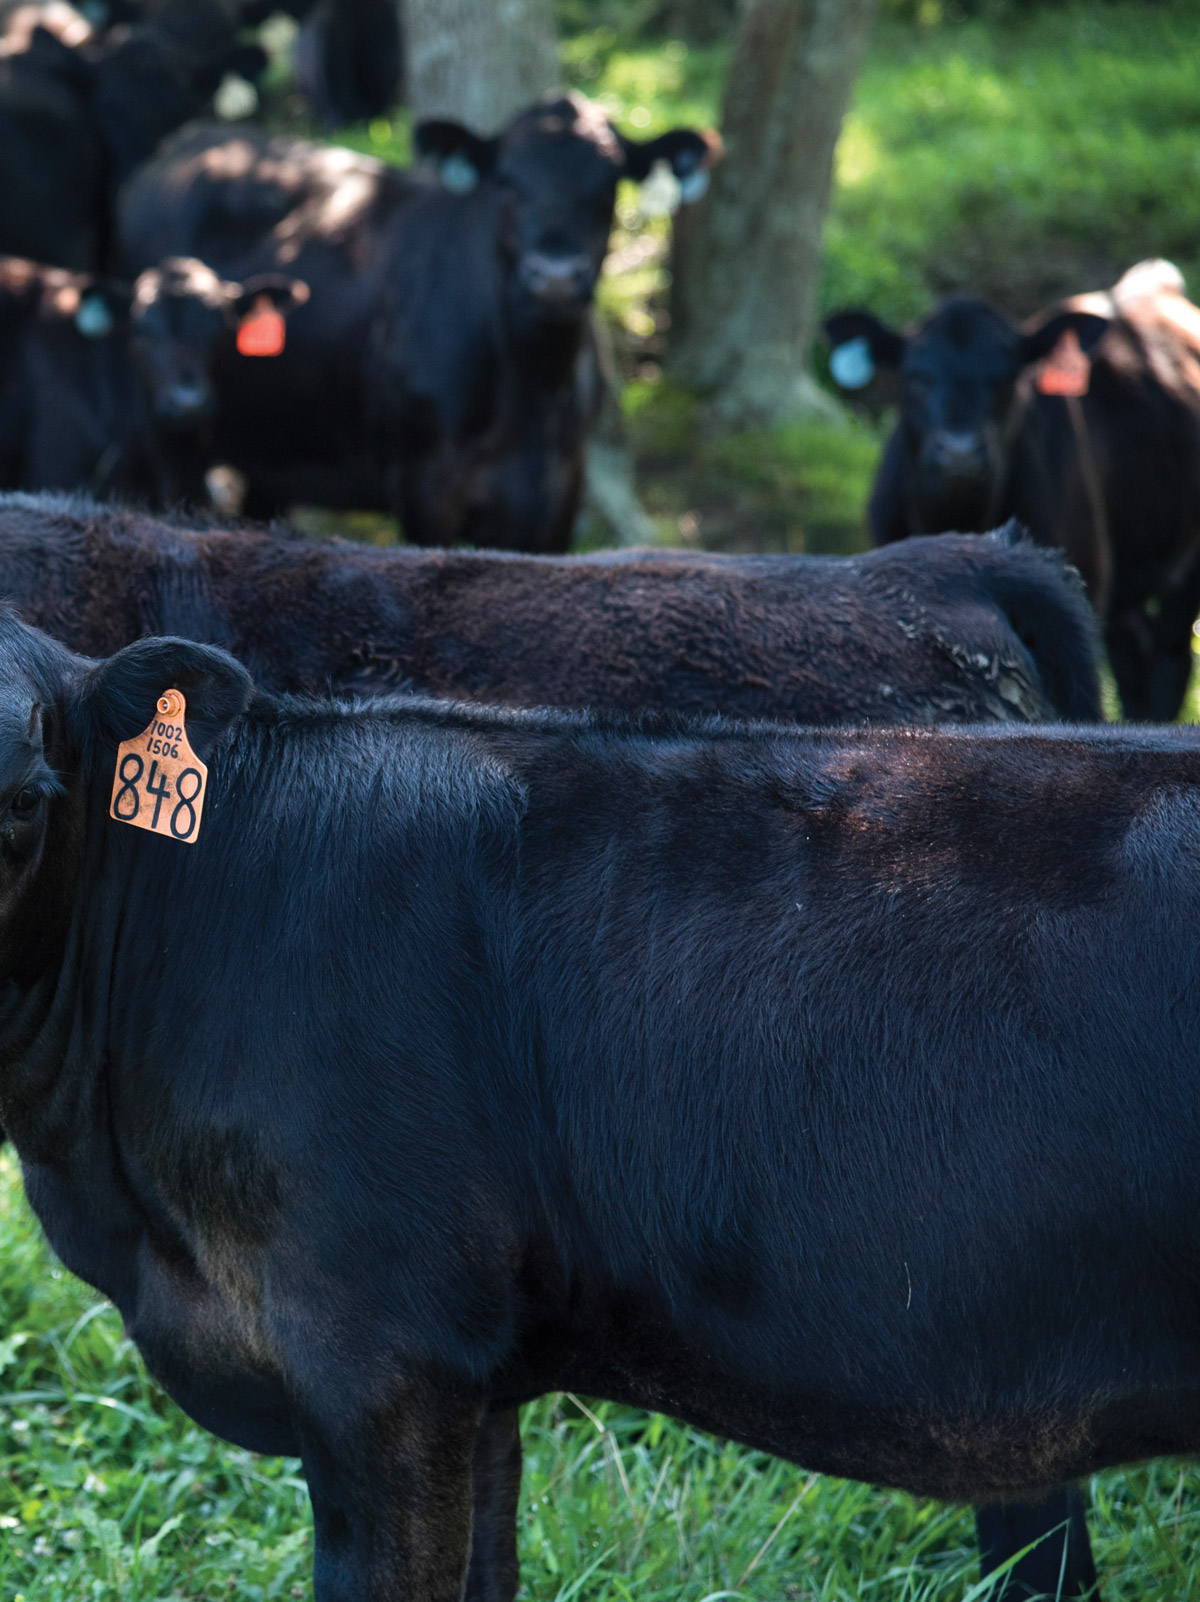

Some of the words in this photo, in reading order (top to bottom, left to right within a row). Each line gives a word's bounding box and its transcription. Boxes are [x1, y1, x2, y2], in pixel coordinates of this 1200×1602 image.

[150, 720, 183, 742] 1002
[146, 737, 179, 759] 1506
[113, 753, 202, 840] 848
